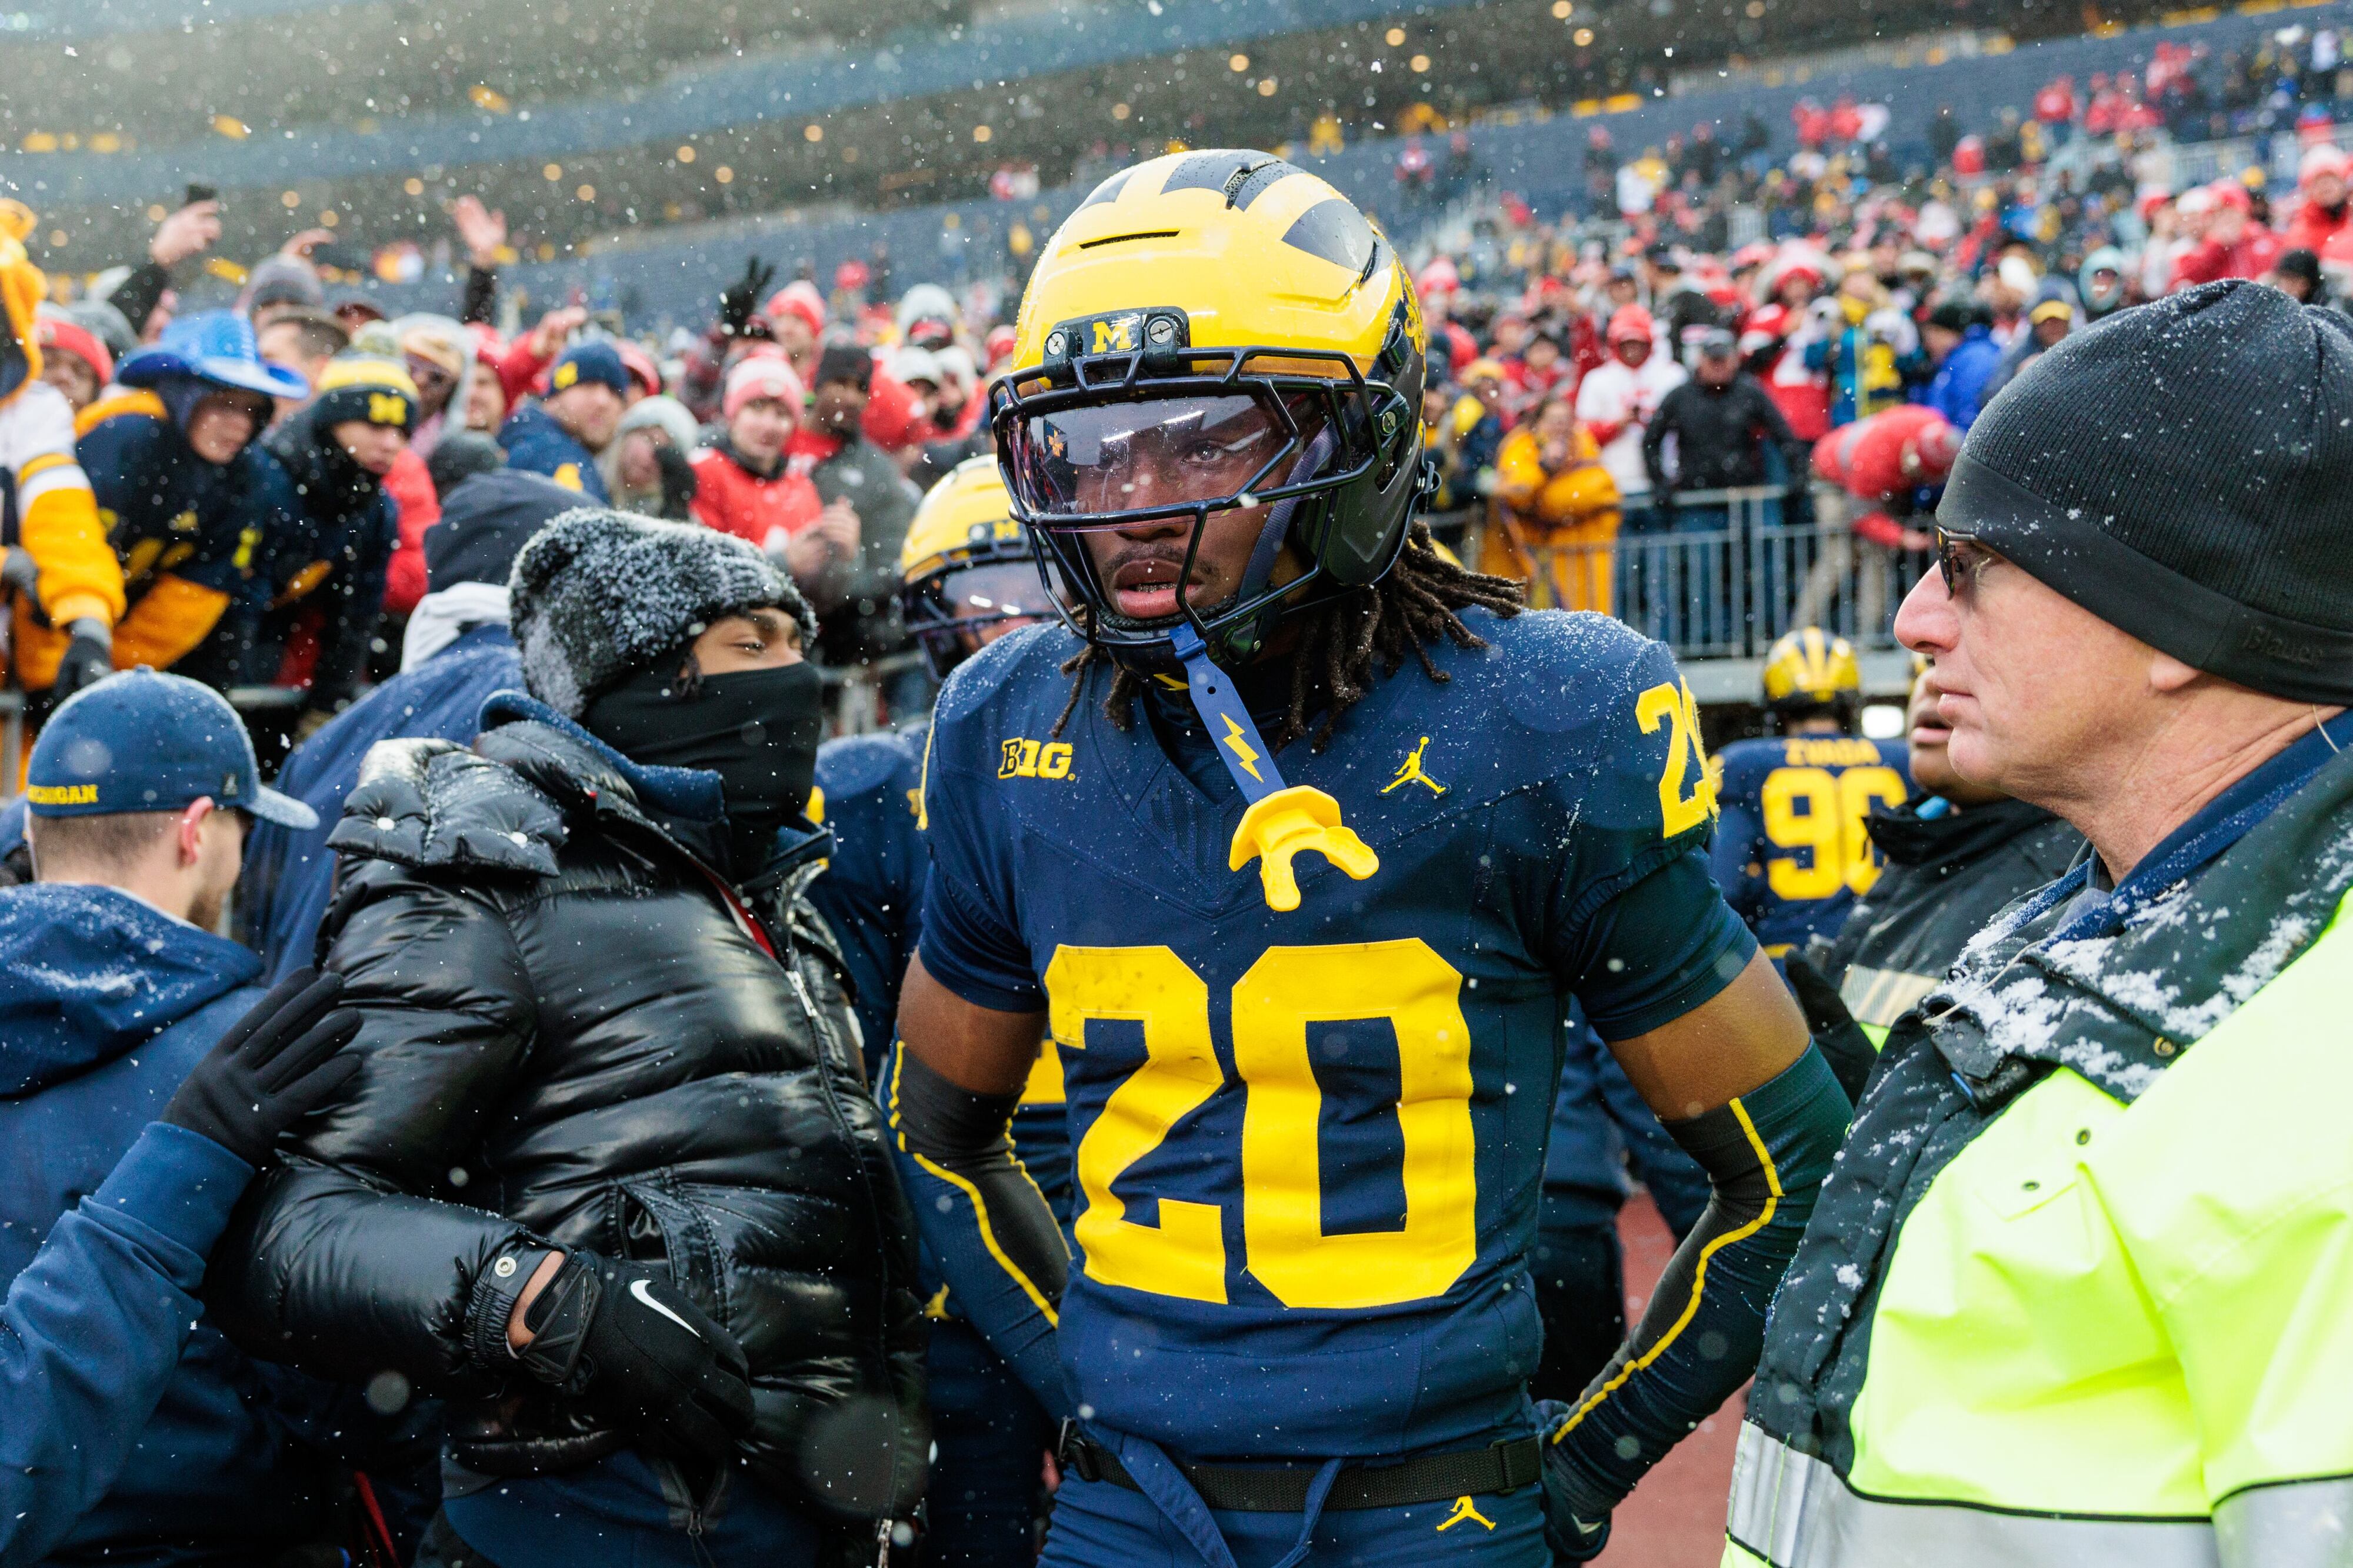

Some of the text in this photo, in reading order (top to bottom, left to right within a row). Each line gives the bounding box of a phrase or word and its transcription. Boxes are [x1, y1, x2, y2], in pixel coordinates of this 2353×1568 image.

[1092, 321, 1132, 354] M
[368, 393, 407, 425] M
[994, 520, 1021, 541] M
[1044, 938, 1478, 1309] 20
